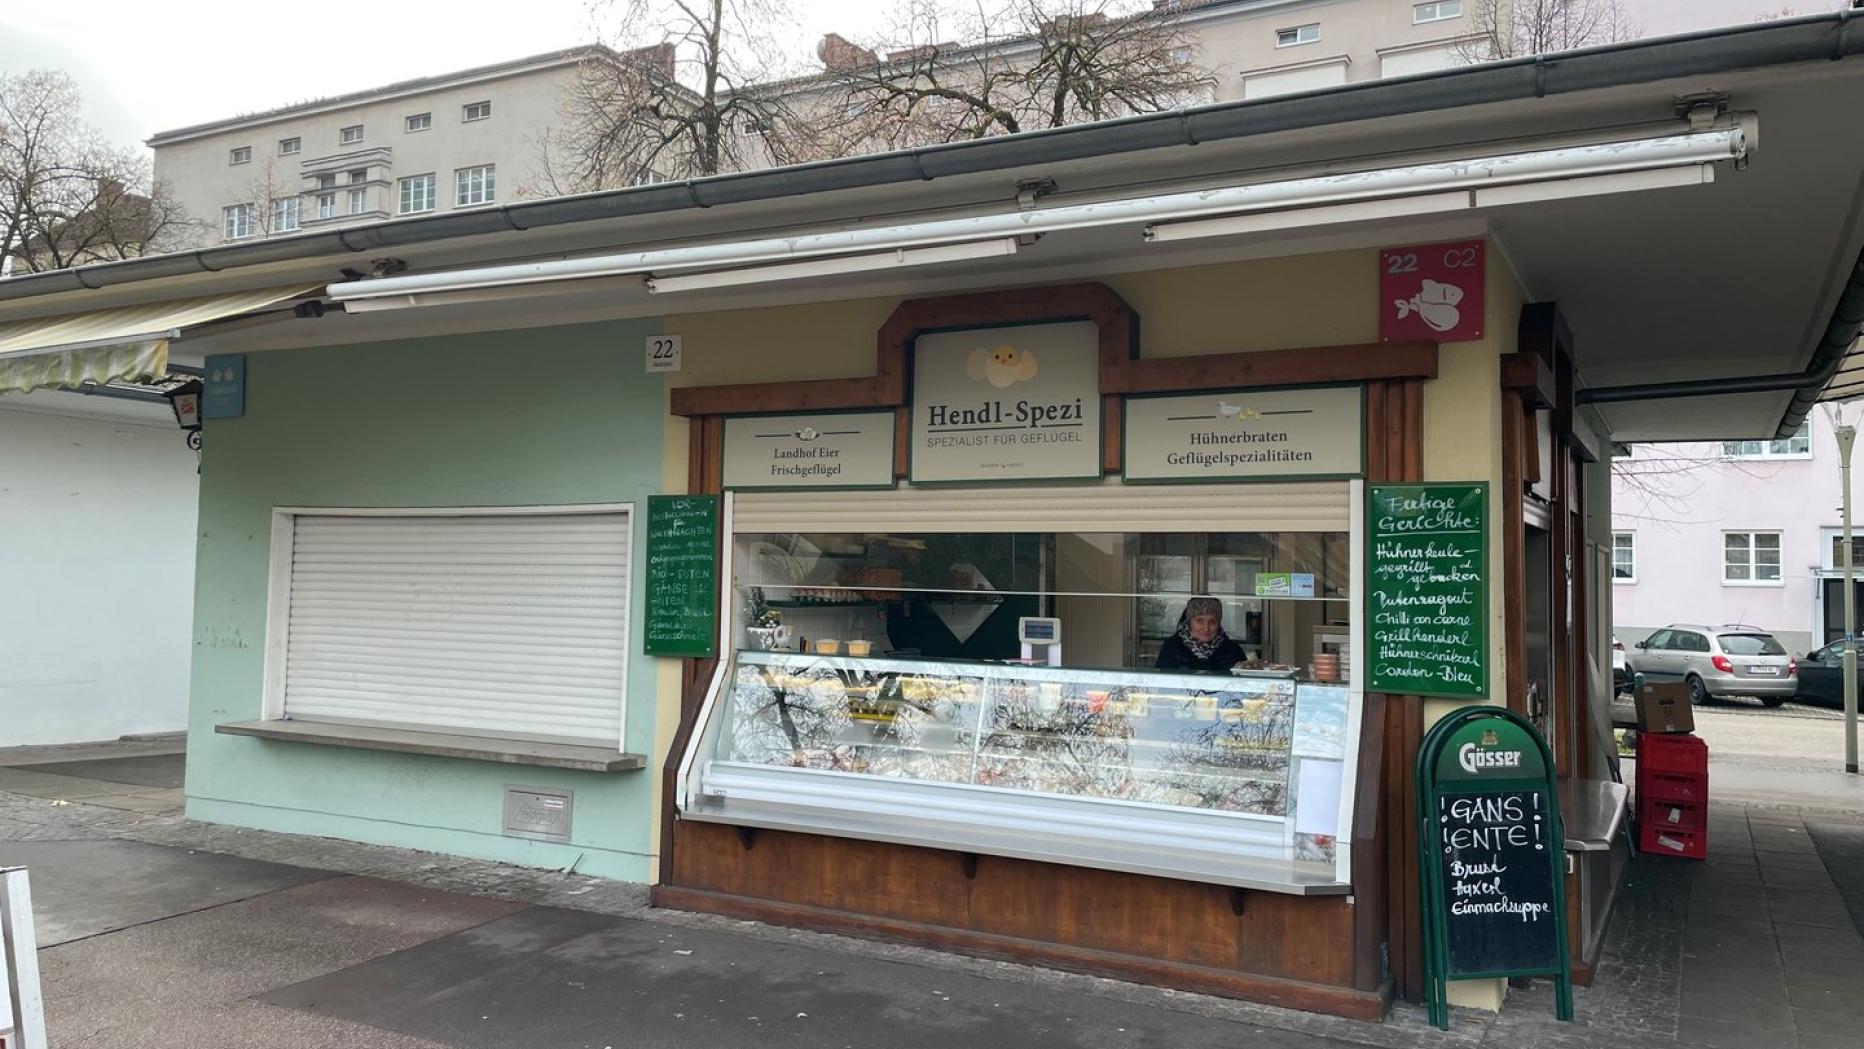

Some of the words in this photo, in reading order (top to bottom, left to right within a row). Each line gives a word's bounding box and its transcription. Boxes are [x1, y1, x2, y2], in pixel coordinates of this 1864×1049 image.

[1388, 254, 1418, 273] 22
[1443, 248, 1476, 268] C2
[653, 339, 673, 359] 22
[928, 398, 1083, 428] Hendl-Spezi
[927, 435, 989, 448] SPEZIALIST
[993, 433, 1017, 446] FÜR
[1020, 431, 1082, 444] GEFLÜGEL
[1190, 431, 1288, 445] Hühnerbraten
[774, 447, 816, 459] Landhof
[819, 447, 840, 458] Eier
[1167, 449, 1312, 467] Geflügelspezialitäten
[771, 463, 841, 478] Frischgeflügel
[1384, 492, 1455, 521] Fertige
[1459, 742, 1521, 774] Gösser
[1451, 895, 1551, 922] Einmachsuppe
